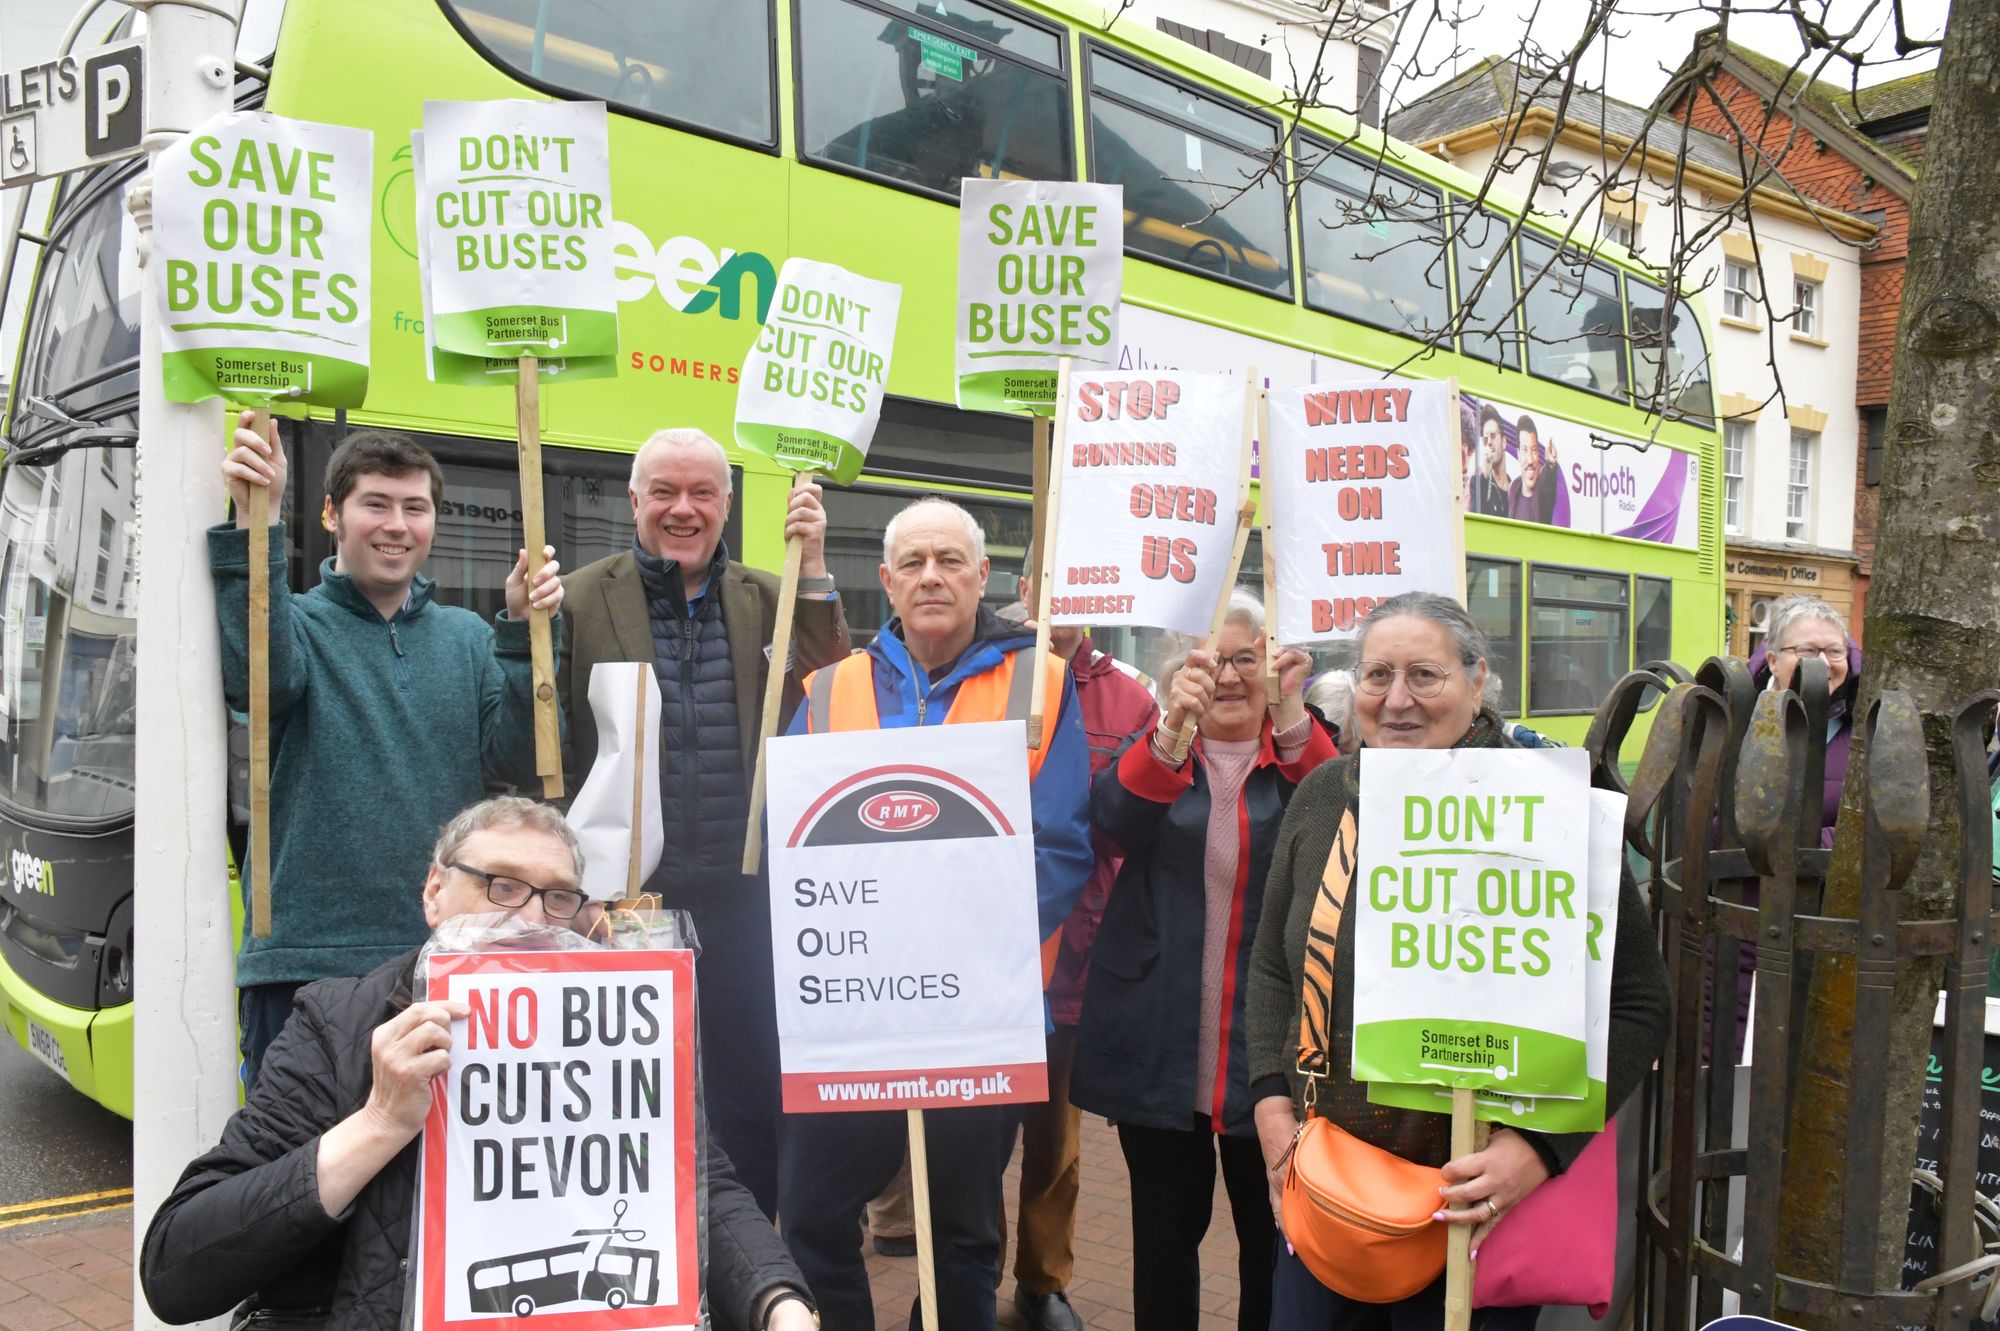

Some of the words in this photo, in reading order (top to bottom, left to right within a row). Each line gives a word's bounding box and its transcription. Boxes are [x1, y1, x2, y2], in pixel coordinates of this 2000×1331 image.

[188, 135, 336, 203] SAVE
[460, 134, 575, 173] DON'T
[436, 190, 511, 229] CUT
[527, 191, 604, 229] OUR
[987, 203, 1098, 247] SAVE
[203, 199, 324, 261] OUR
[456, 233, 588, 272] BUSES
[166, 259, 359, 324] BUSES
[614, 220, 777, 325] een
[998, 254, 1086, 296] OUR
[393, 311, 424, 335] fro
[486, 315, 537, 327] Somerset
[541, 315, 560, 327] Bus
[781, 284, 871, 332] DON'T
[968, 303, 1111, 346] BUSES
[487, 328, 548, 341] Partnership
[755, 323, 817, 363] CUT
[827, 340, 884, 384] OUR
[215, 357, 276, 373] Somerset
[281, 360, 304, 374] Bus
[216, 371, 290, 387] Partnership
[631, 352, 738, 385] SOMERS
[1004, 377, 1048, 389] Somerset
[763, 361, 868, 414] BUSES
[1004, 388, 1057, 401] Partnership
[1077, 380, 1180, 423] STOP
[1304, 388, 1412, 427] WIVEY
[776, 443, 828, 461] Partnership
[777, 433, 820, 449] Somerset
[822, 439, 838, 453] Bus
[1072, 442, 1176, 468] RUNNING
[1305, 444, 1410, 483] NEEDS
[1572, 462, 1636, 498] Smooth
[1129, 483, 1217, 526] OVER
[1337, 486, 1383, 521] ON
[1619, 500, 1636, 512] Radio
[1067, 566, 1120, 585] BUSES
[1141, 535, 1197, 584] US
[1321, 541, 1402, 577] TIME
[1737, 561, 1789, 580] Community
[1791, 566, 1817, 581] Office
[1050, 595, 1135, 616] SOMERSET
[1311, 596, 1388, 634] BUS
[879, 804, 923, 820] RMT
[1403, 795, 1544, 843] DON'T
[12, 849, 55, 896] green
[1369, 865, 1458, 914] CUT
[1477, 868, 1576, 919] OUR
[1391, 922, 1551, 977] BUSES
[467, 986, 538, 1050] NO
[562, 984, 660, 1048] BUS
[1421, 1029, 1480, 1048] Somerset
[1485, 1034, 1509, 1050] Bus
[1421, 1045, 1495, 1065] Partnership
[460, 1059, 592, 1127] CUTS
[612, 1058, 661, 1120] IN
[818, 1072, 1012, 1103] www.rmt.org.uk
[473, 1131, 650, 1202] DEVON
